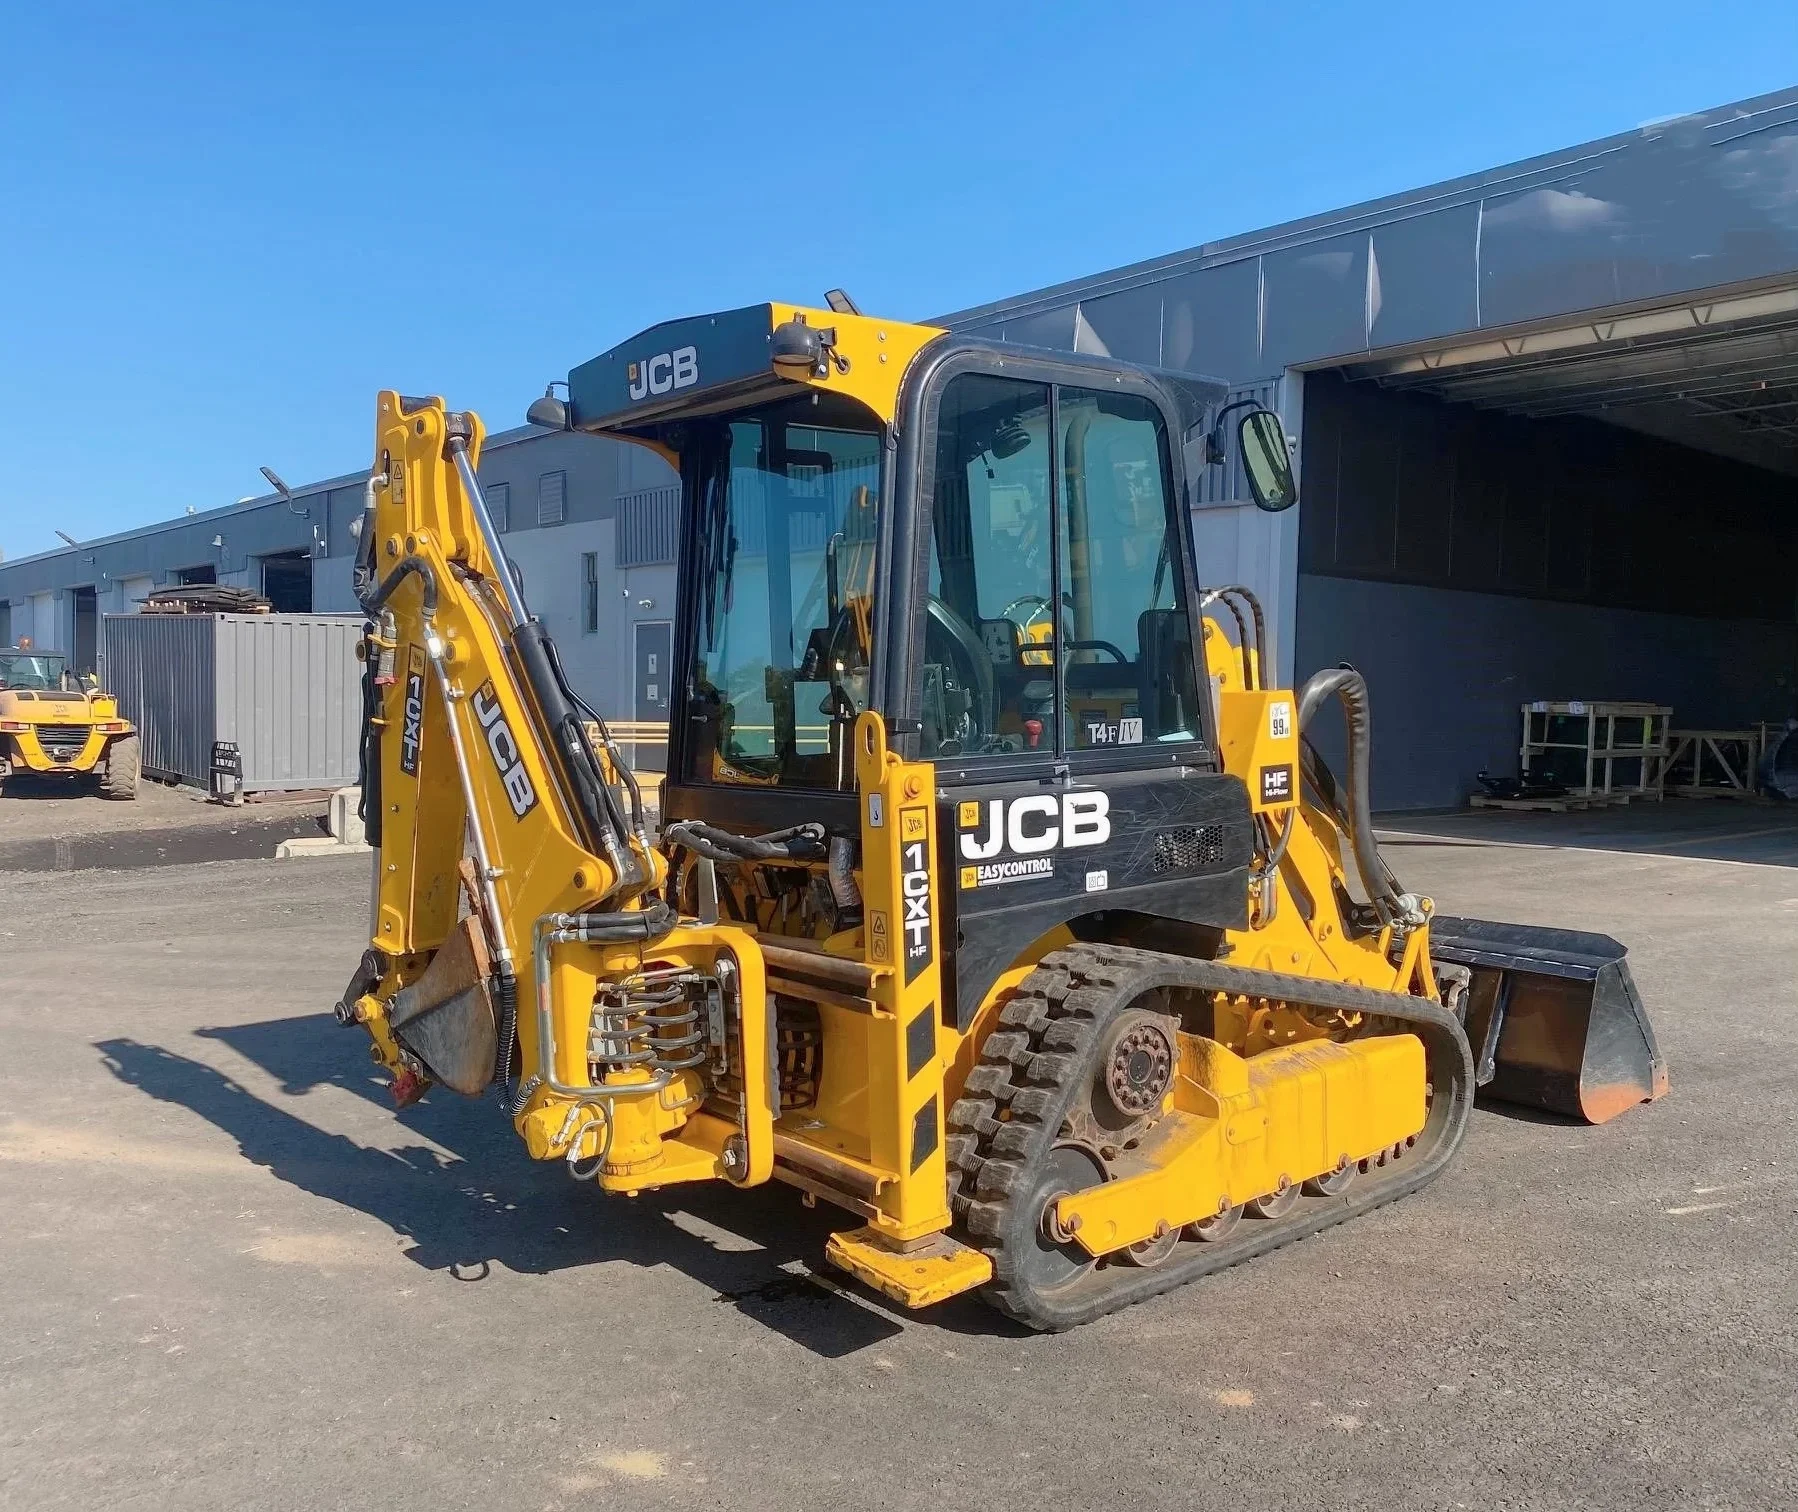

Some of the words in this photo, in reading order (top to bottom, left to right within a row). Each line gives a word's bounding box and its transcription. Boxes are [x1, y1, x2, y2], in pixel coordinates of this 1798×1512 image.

[629, 346, 698, 400] JCB
[403, 675, 421, 760] 1CXT
[1273, 718, 1284, 735] 99
[403, 761, 415, 771] HF
[473, 691, 535, 816] JCB
[1264, 771, 1288, 788] HF
[959, 790, 1111, 860] JCB
[903, 842, 930, 945] 1CXT
[909, 945, 927, 958] HF
